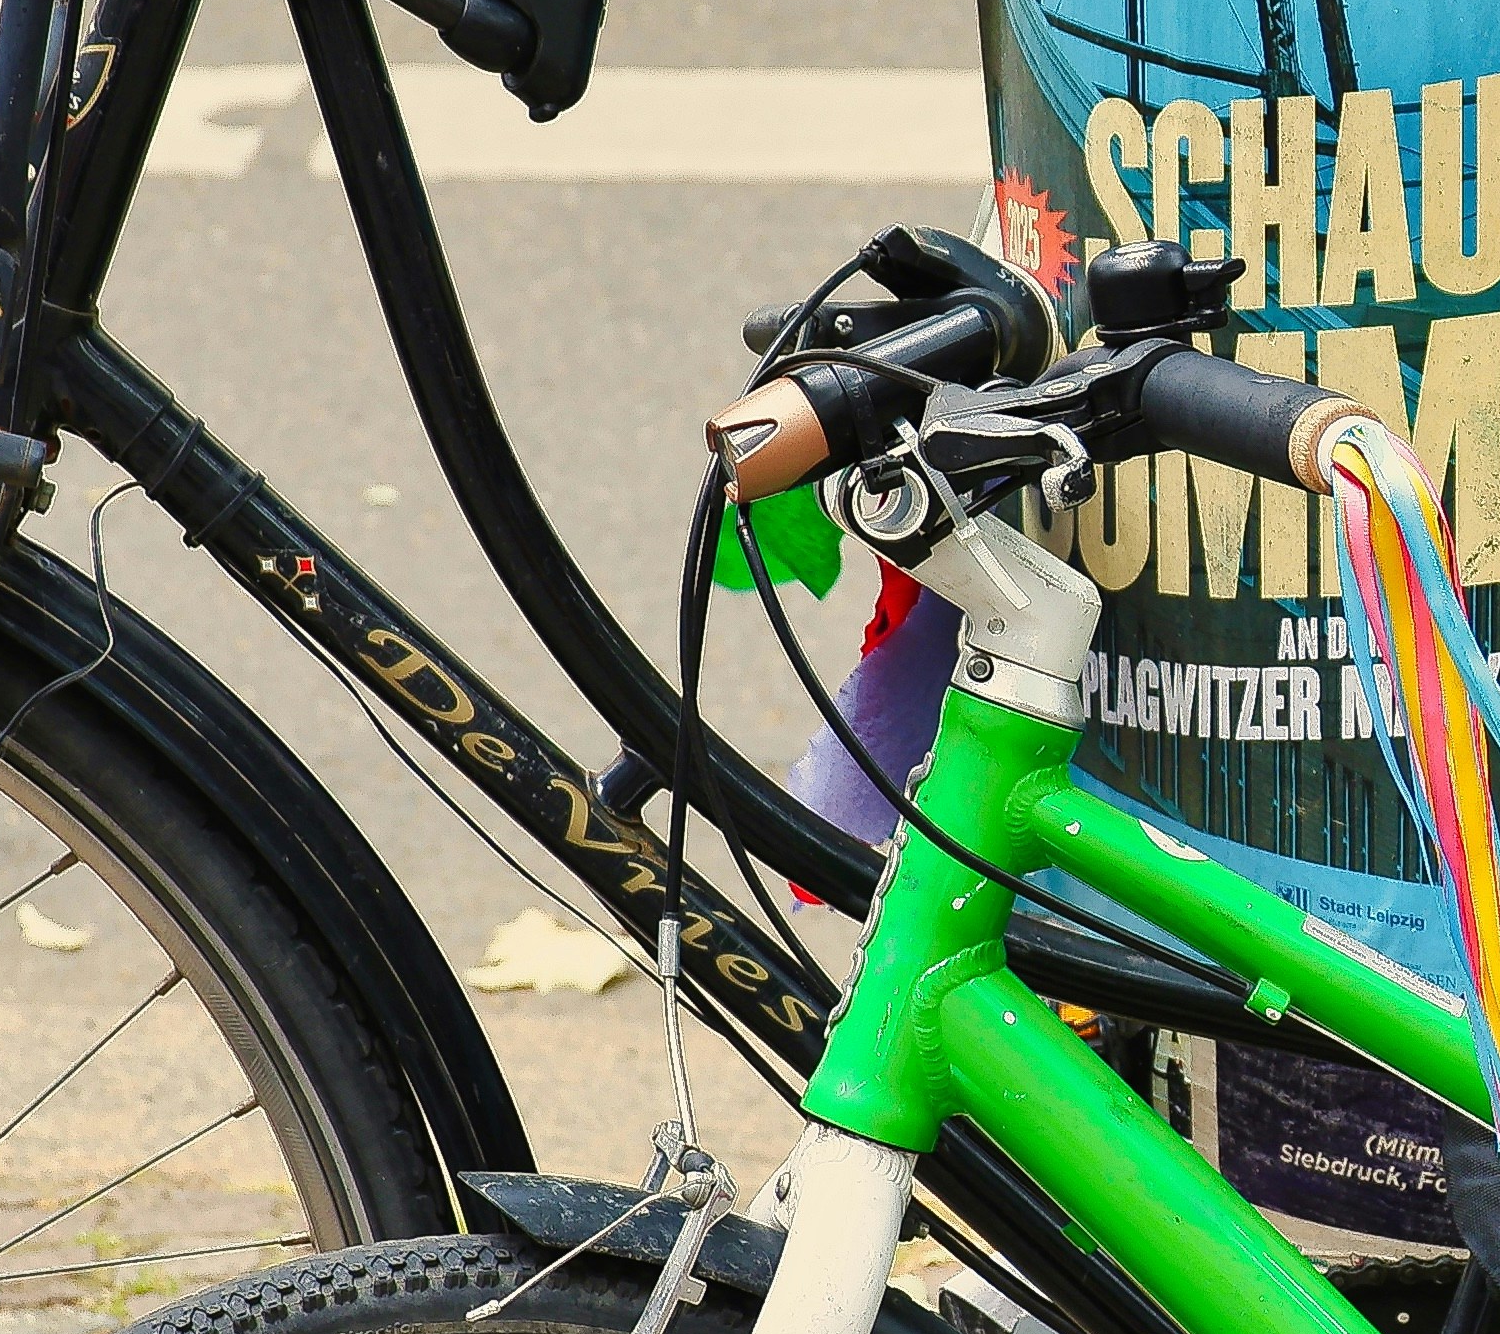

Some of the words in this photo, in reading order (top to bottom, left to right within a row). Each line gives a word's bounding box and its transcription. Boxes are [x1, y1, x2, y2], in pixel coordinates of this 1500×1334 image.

[1005, 197, 1041, 271] 2025
[1278, 616, 1319, 661] AN
[1084, 651, 1323, 742] PLAGWITZER
[358, 627, 516, 763] De
[550, 778, 812, 1034] Vries
[1318, 895, 1364, 918] Stadt
[1366, 905, 1428, 933] Leipzig
[1279, 1142, 1409, 1191] Siebdruck,
